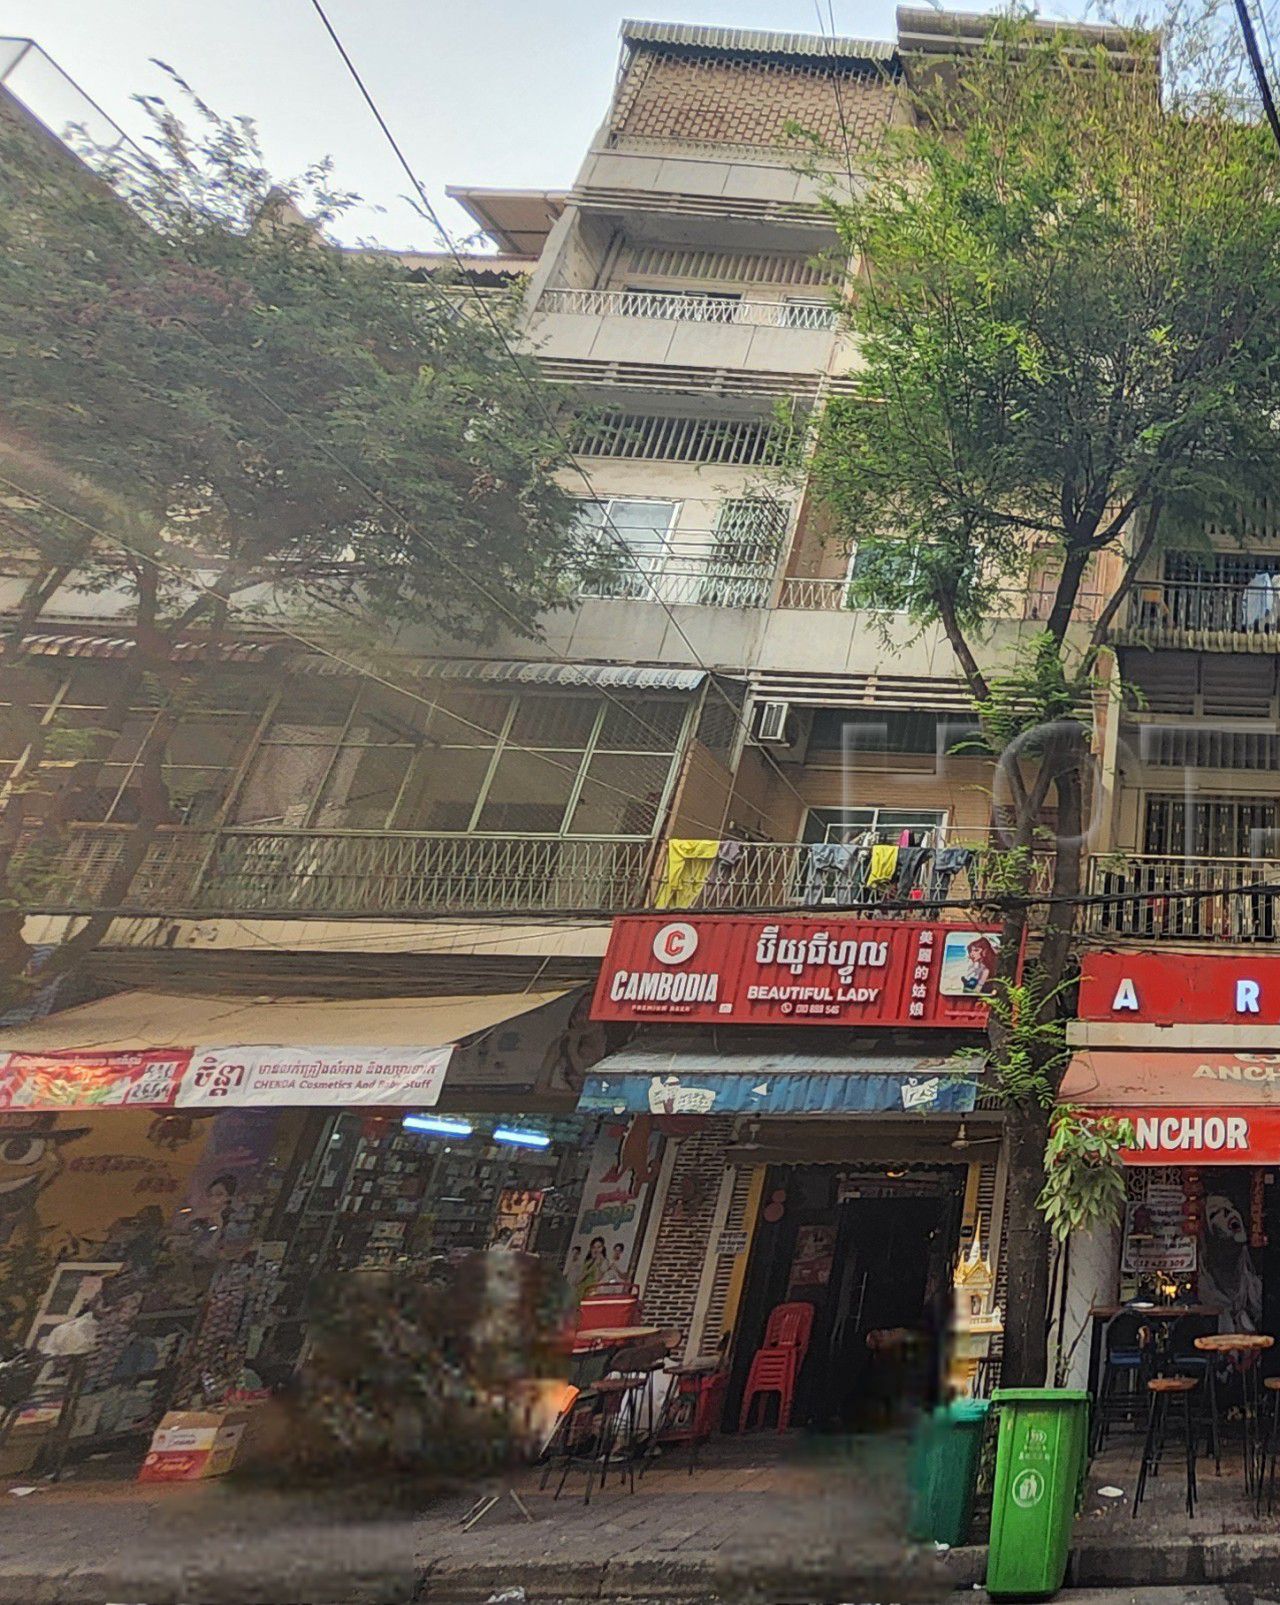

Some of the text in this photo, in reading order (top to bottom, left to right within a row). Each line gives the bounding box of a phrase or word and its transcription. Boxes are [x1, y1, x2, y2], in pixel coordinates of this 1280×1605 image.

[610, 969, 719, 1003] CAMBODIA
[746, 985, 881, 1002] BEAUTIFUL LADY
[1112, 978, 1260, 1013] A R
[253, 1079, 296, 1090] CHENDA
[299, 1079, 354, 1090] Cosmetics
[355, 1080, 376, 1090] And
